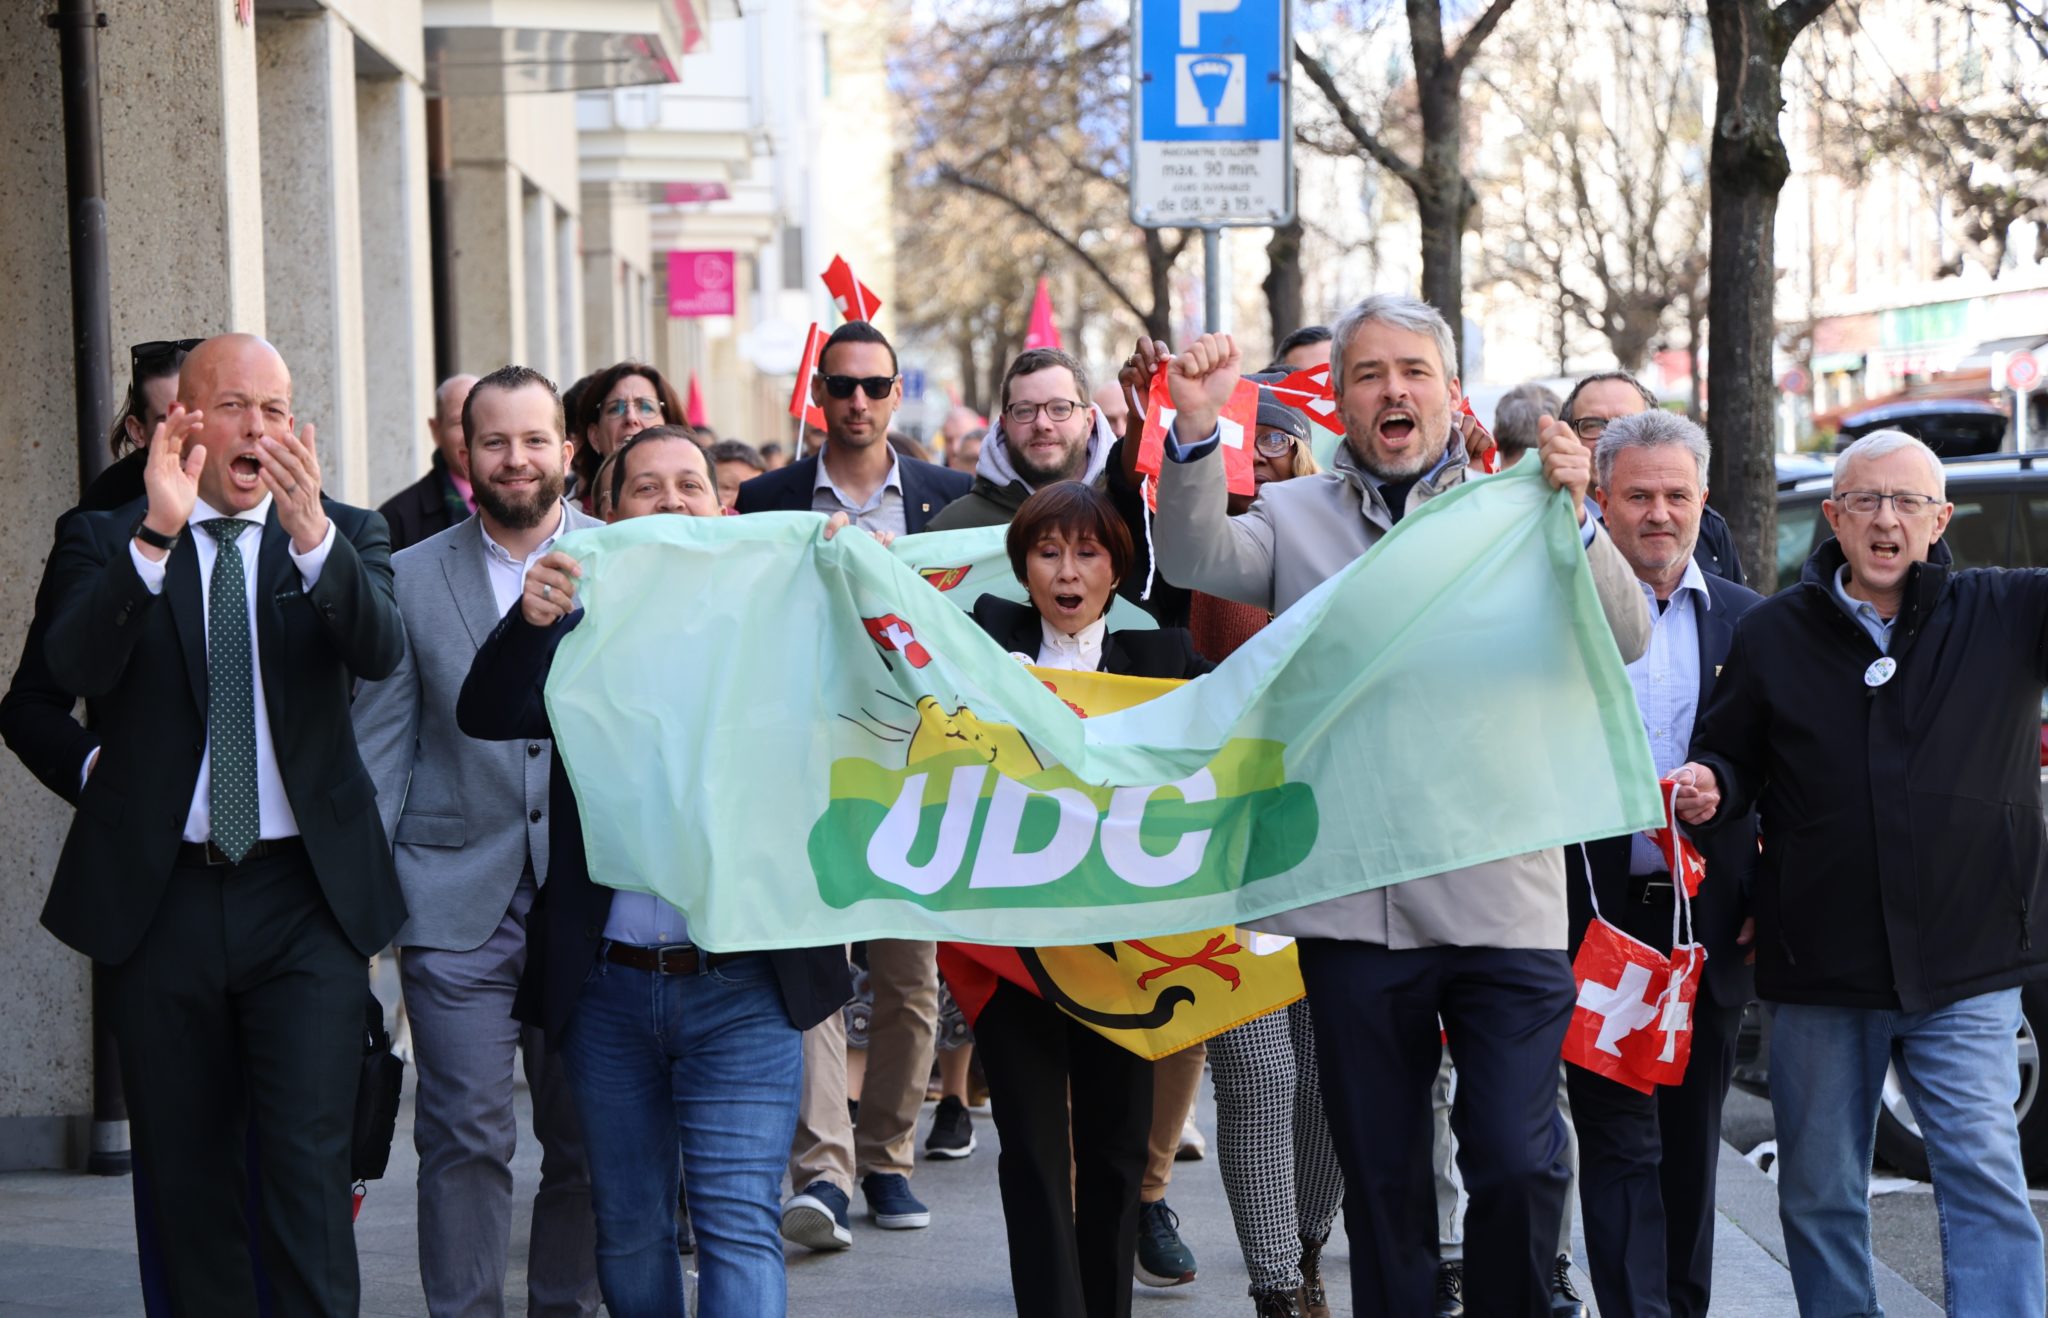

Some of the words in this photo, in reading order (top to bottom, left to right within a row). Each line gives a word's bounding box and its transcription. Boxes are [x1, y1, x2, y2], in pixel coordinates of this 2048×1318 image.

[1161, 163, 1198, 177] max.
[1203, 160, 1224, 177] 90
[1227, 162, 1259, 177] min.
[1157, 196, 1176, 212] de
[866, 764, 1217, 896] UDC
